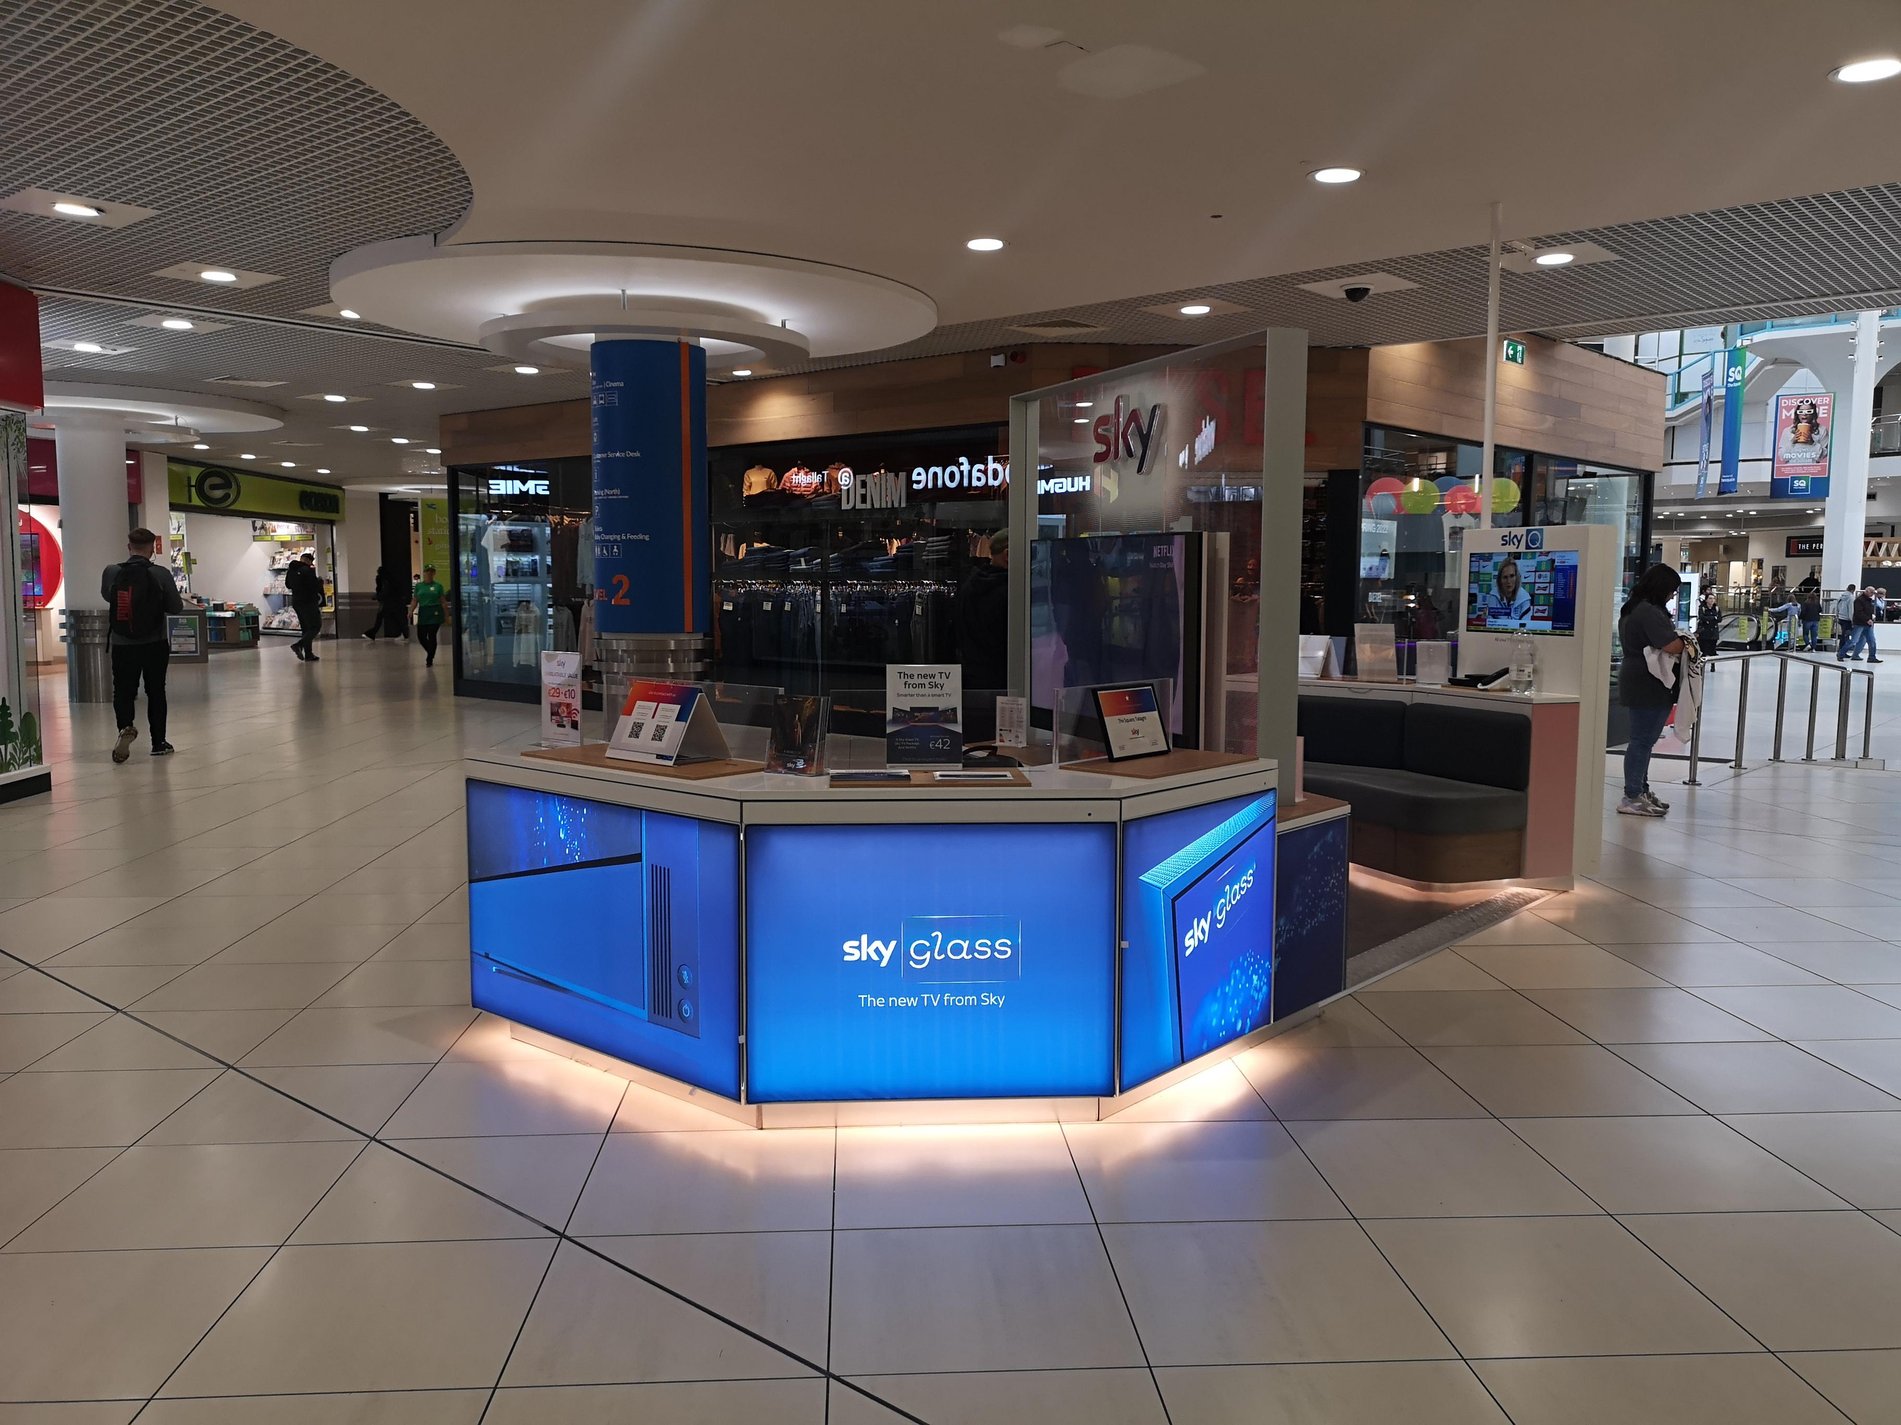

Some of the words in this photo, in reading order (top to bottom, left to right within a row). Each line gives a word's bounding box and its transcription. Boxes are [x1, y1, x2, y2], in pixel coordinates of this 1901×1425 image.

[1781, 397, 1830, 407] DISCOVER
[1782, 406, 1828, 420] ME
[1093, 394, 1163, 475] sky
[1793, 479, 1807, 487] SQ
[841, 472, 907, 510] DENIM
[627, 533, 650, 541] Feeding
[1501, 531, 1524, 549] sky
[1527, 530, 1541, 548] Q
[612, 574, 631, 606] 2
[897, 671, 915, 680] The
[916, 672, 936, 680] new
[937, 671, 951, 680] TV
[903, 681, 926, 690] from
[928, 681, 945, 691] Sky
[563, 688, 576, 700] €10
[929, 738, 951, 750] €42
[1184, 910, 1212, 957] sky
[1216, 869, 1254, 929] glass
[843, 934, 898, 968] sky
[909, 931, 1012, 969] glass
[858, 994, 885, 1007] The
[888, 996, 918, 1007] new
[920, 993, 940, 1007] TV
[943, 992, 977, 1006] from
[980, 992, 1005, 1007] Sky
